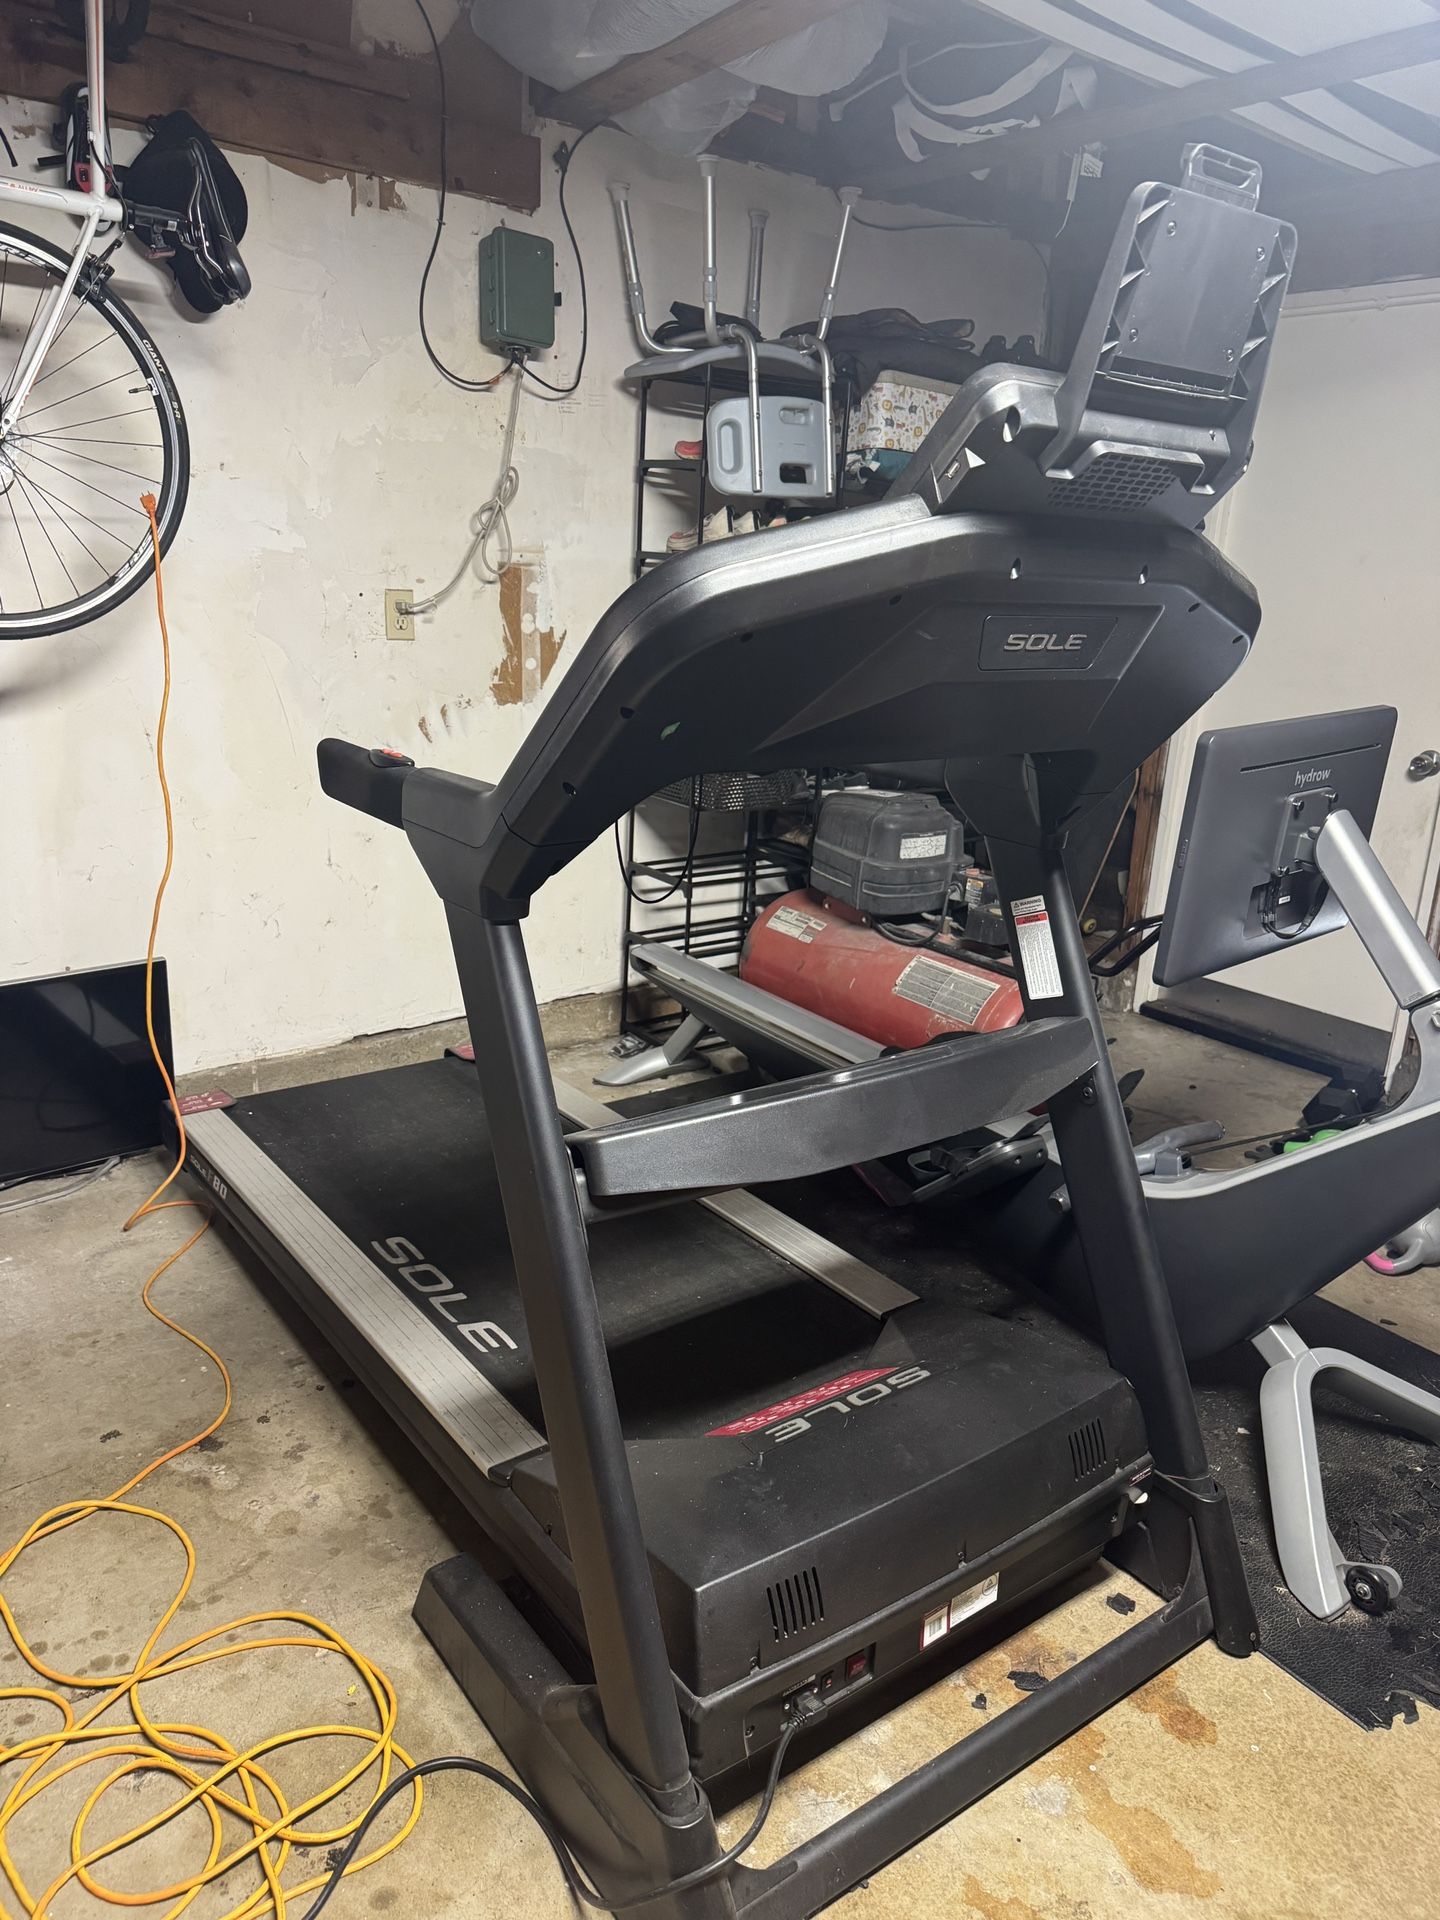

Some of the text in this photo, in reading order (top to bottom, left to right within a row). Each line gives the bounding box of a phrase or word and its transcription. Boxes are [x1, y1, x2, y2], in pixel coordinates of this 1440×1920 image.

[143, 340, 165, 375] GIANT
[1004, 634, 1087, 651] SOLE
[1294, 768, 1331, 788] hydrow
[1020, 899, 1042, 907] WARNING
[371, 1237, 518, 1353] SOLE
[765, 1366, 931, 1443] SOLE
